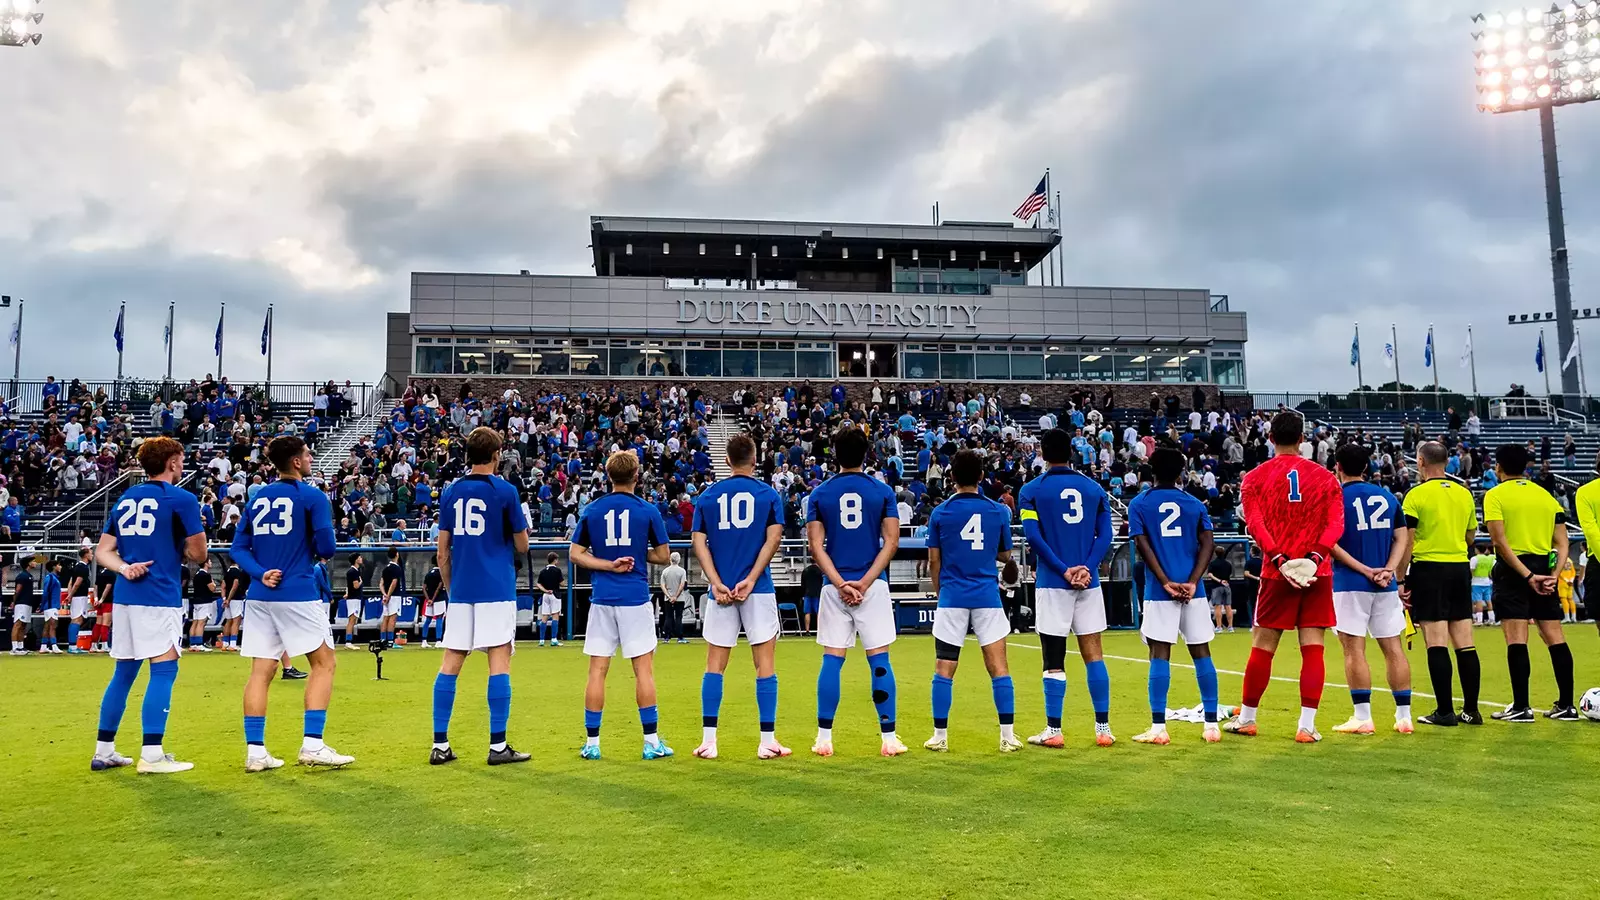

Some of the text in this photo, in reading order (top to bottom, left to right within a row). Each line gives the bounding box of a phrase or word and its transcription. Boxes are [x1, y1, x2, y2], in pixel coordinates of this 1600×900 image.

[677, 300, 981, 328] DUKE UNIVERSITY
[1287, 469, 1302, 502] 1
[117, 498, 159, 536] 26
[252, 497, 294, 536] 23
[453, 498, 487, 536] 16
[717, 492, 755, 530] 10
[839, 492, 863, 530] 8
[1060, 488, 1084, 524] 3
[1158, 502, 1182, 537] 2
[1353, 495, 1391, 531] 12
[604, 509, 632, 546] 11
[959, 513, 984, 550] 4
[402, 596, 413, 606] 15
